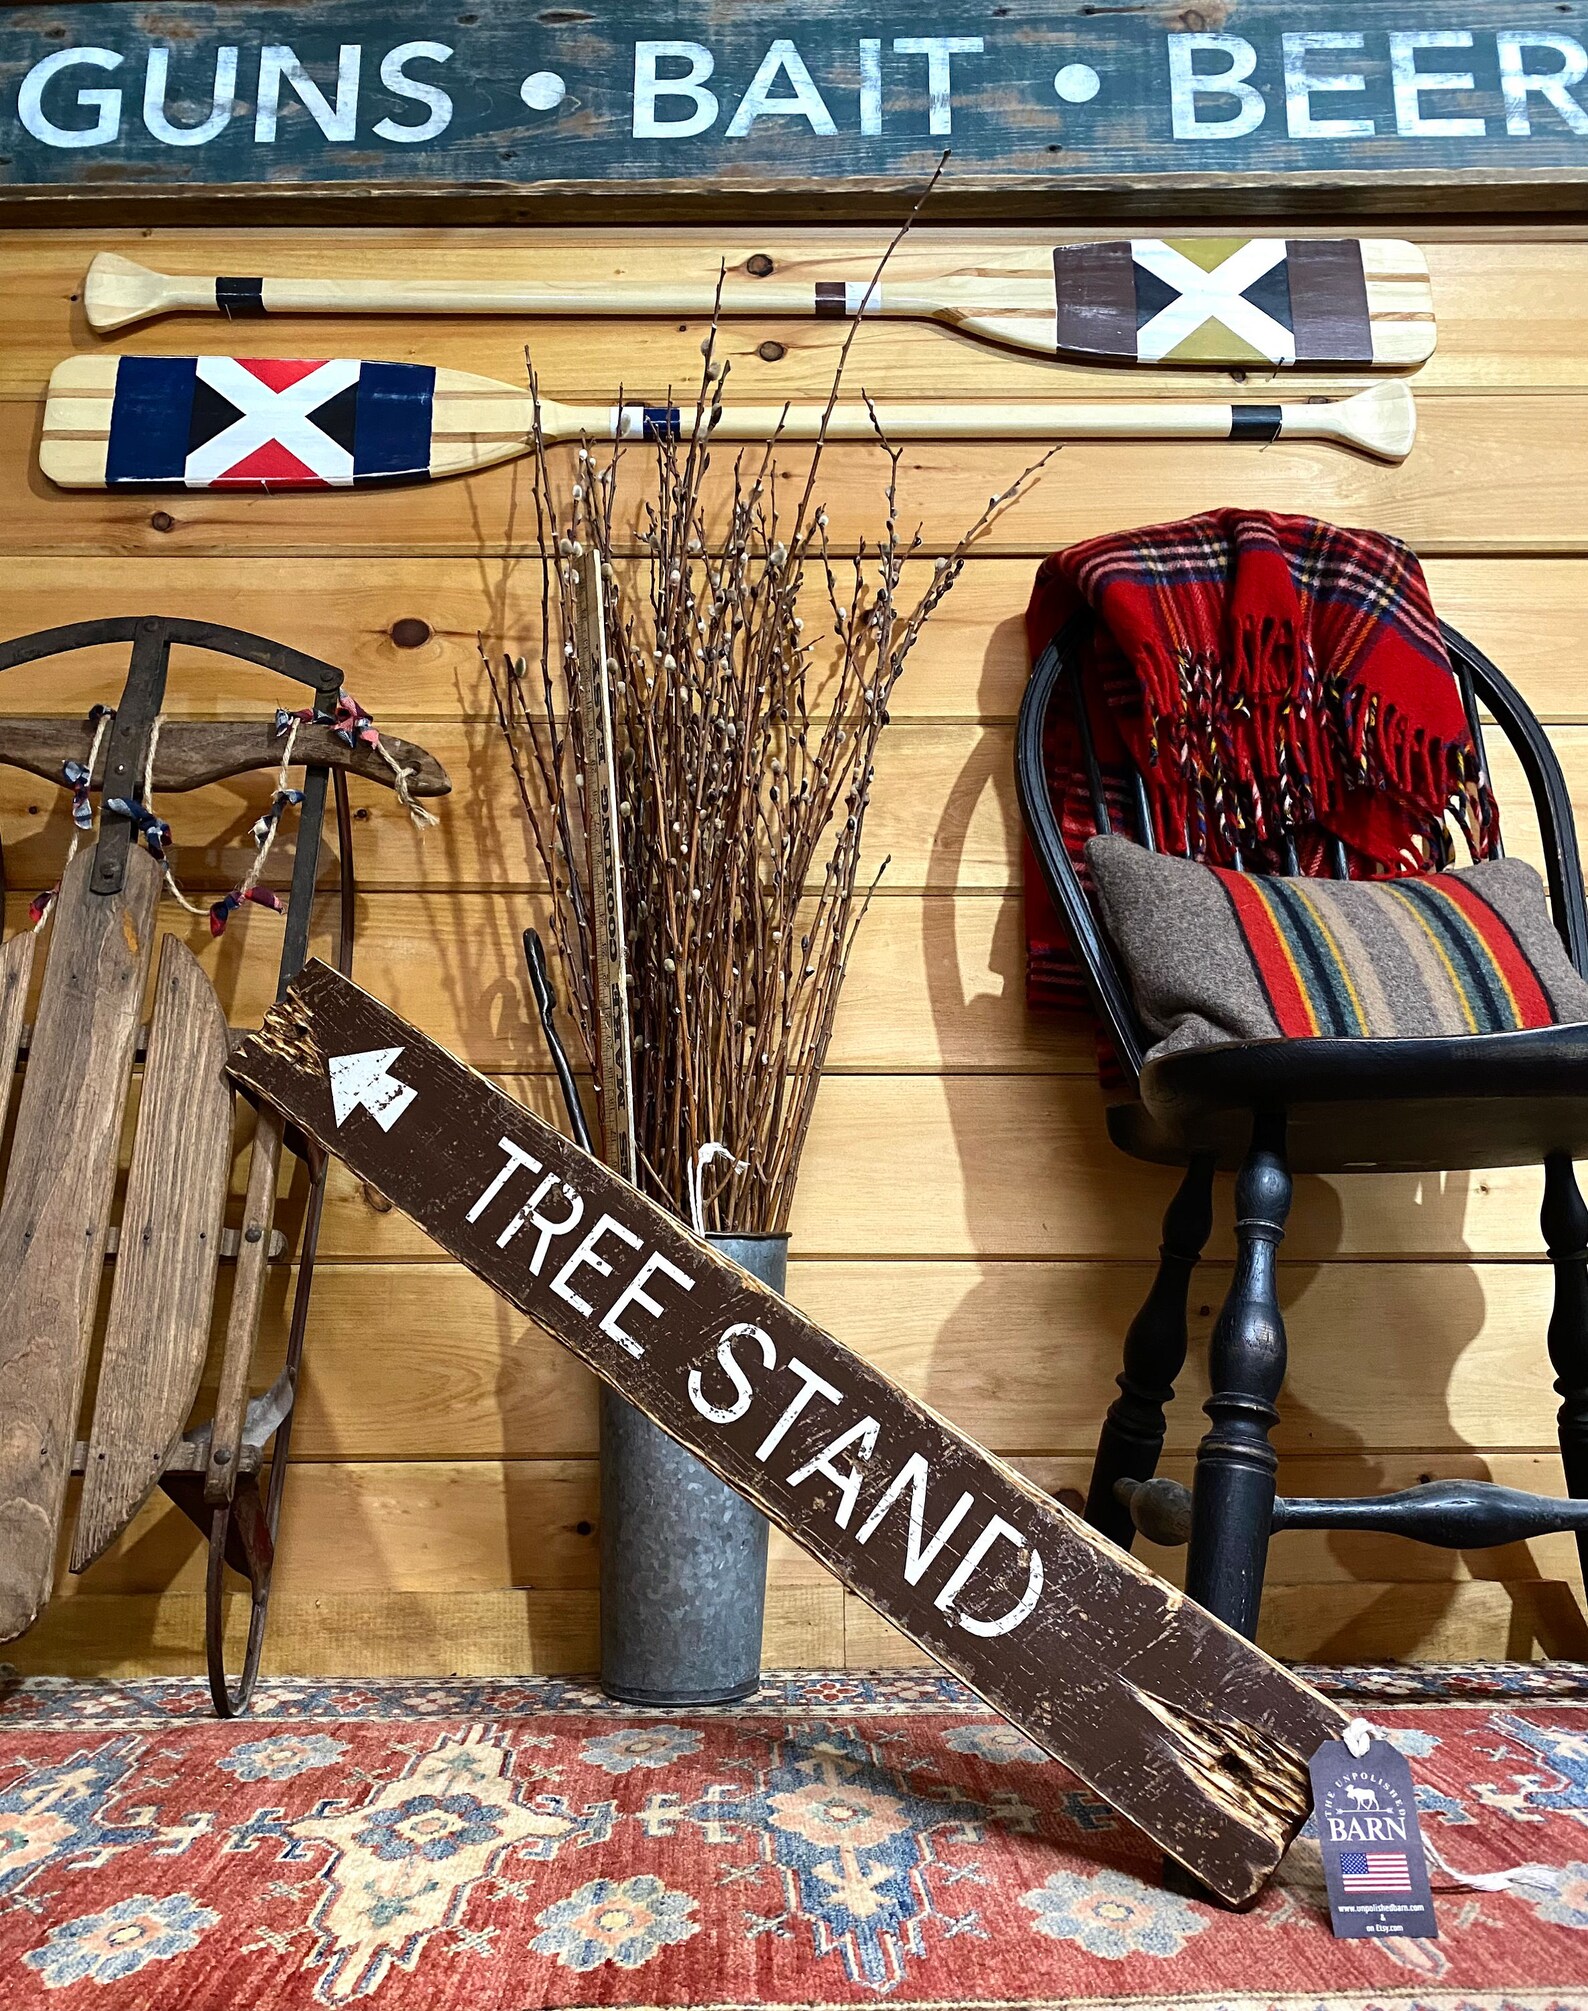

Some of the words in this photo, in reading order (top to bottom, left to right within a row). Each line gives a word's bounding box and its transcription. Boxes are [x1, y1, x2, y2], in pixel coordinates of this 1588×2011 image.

[17, 40, 454, 148] GUNS
[632, 36, 984, 139] BAIT
[1168, 31, 1588, 140] BEER
[600, 784, 616, 962] COOKING
[611, 982, 625, 1110] MAKE
[465, 1136, 696, 1360] TREE
[687, 1323, 1045, 1638] STAND
[1324, 1791, 1336, 1817] THE
[1335, 1772, 1407, 1816] UNPOLISHED
[1327, 1817, 1407, 1842] BARN
[1338, 1903, 1425, 1914] www.unpolishedbarn.com
[1366, 1924, 1375, 1932] on
[1376, 1923, 1404, 1933] Etsy.com
